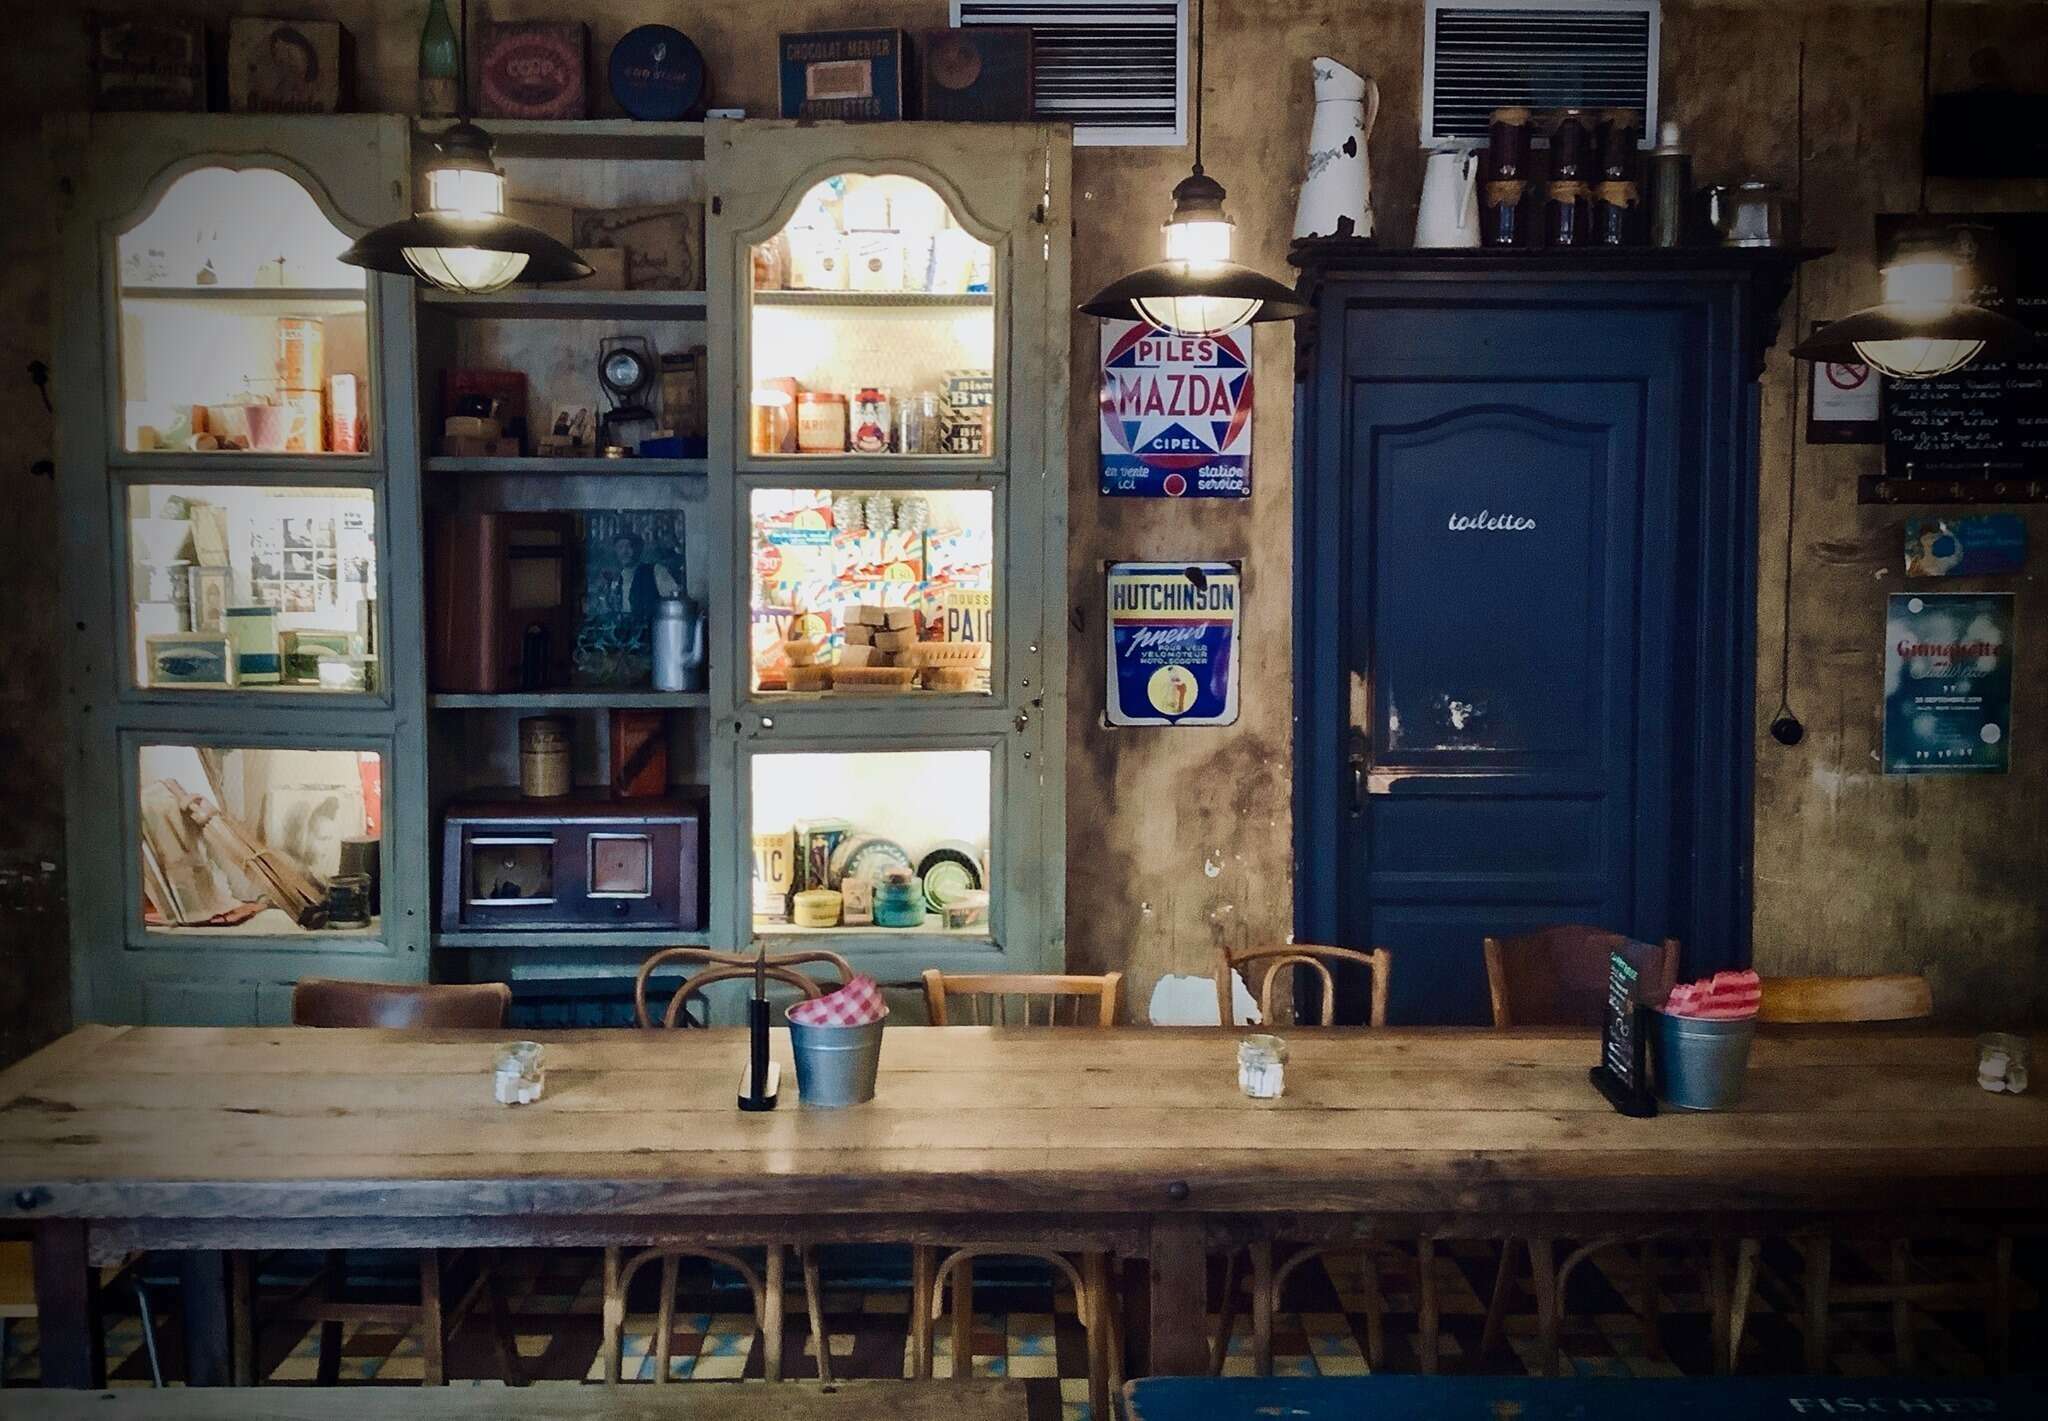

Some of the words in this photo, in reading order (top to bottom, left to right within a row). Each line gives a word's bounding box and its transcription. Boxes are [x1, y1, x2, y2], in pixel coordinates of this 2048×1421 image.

[787, 41, 841, 61] CHOCOLAT
[847, 38, 891, 57] MENIER
[1139, 340, 1213, 362] PILES
[1119, 374, 1232, 417] MAZDA
[1152, 438, 1200, 450] CIPEL
[1105, 466, 1117, 477] en
[1120, 465, 1149, 477] vente
[1198, 464, 1244, 477] station
[1118, 479, 1136, 490] ici
[1198, 478, 1244, 490] service
[1448, 509, 1537, 531] toilettes
[1114, 583, 1234, 611] HUTCHINSON
[1125, 621, 1210, 657] pneus
[1788, 1396, 1999, 1414] FISCHER
